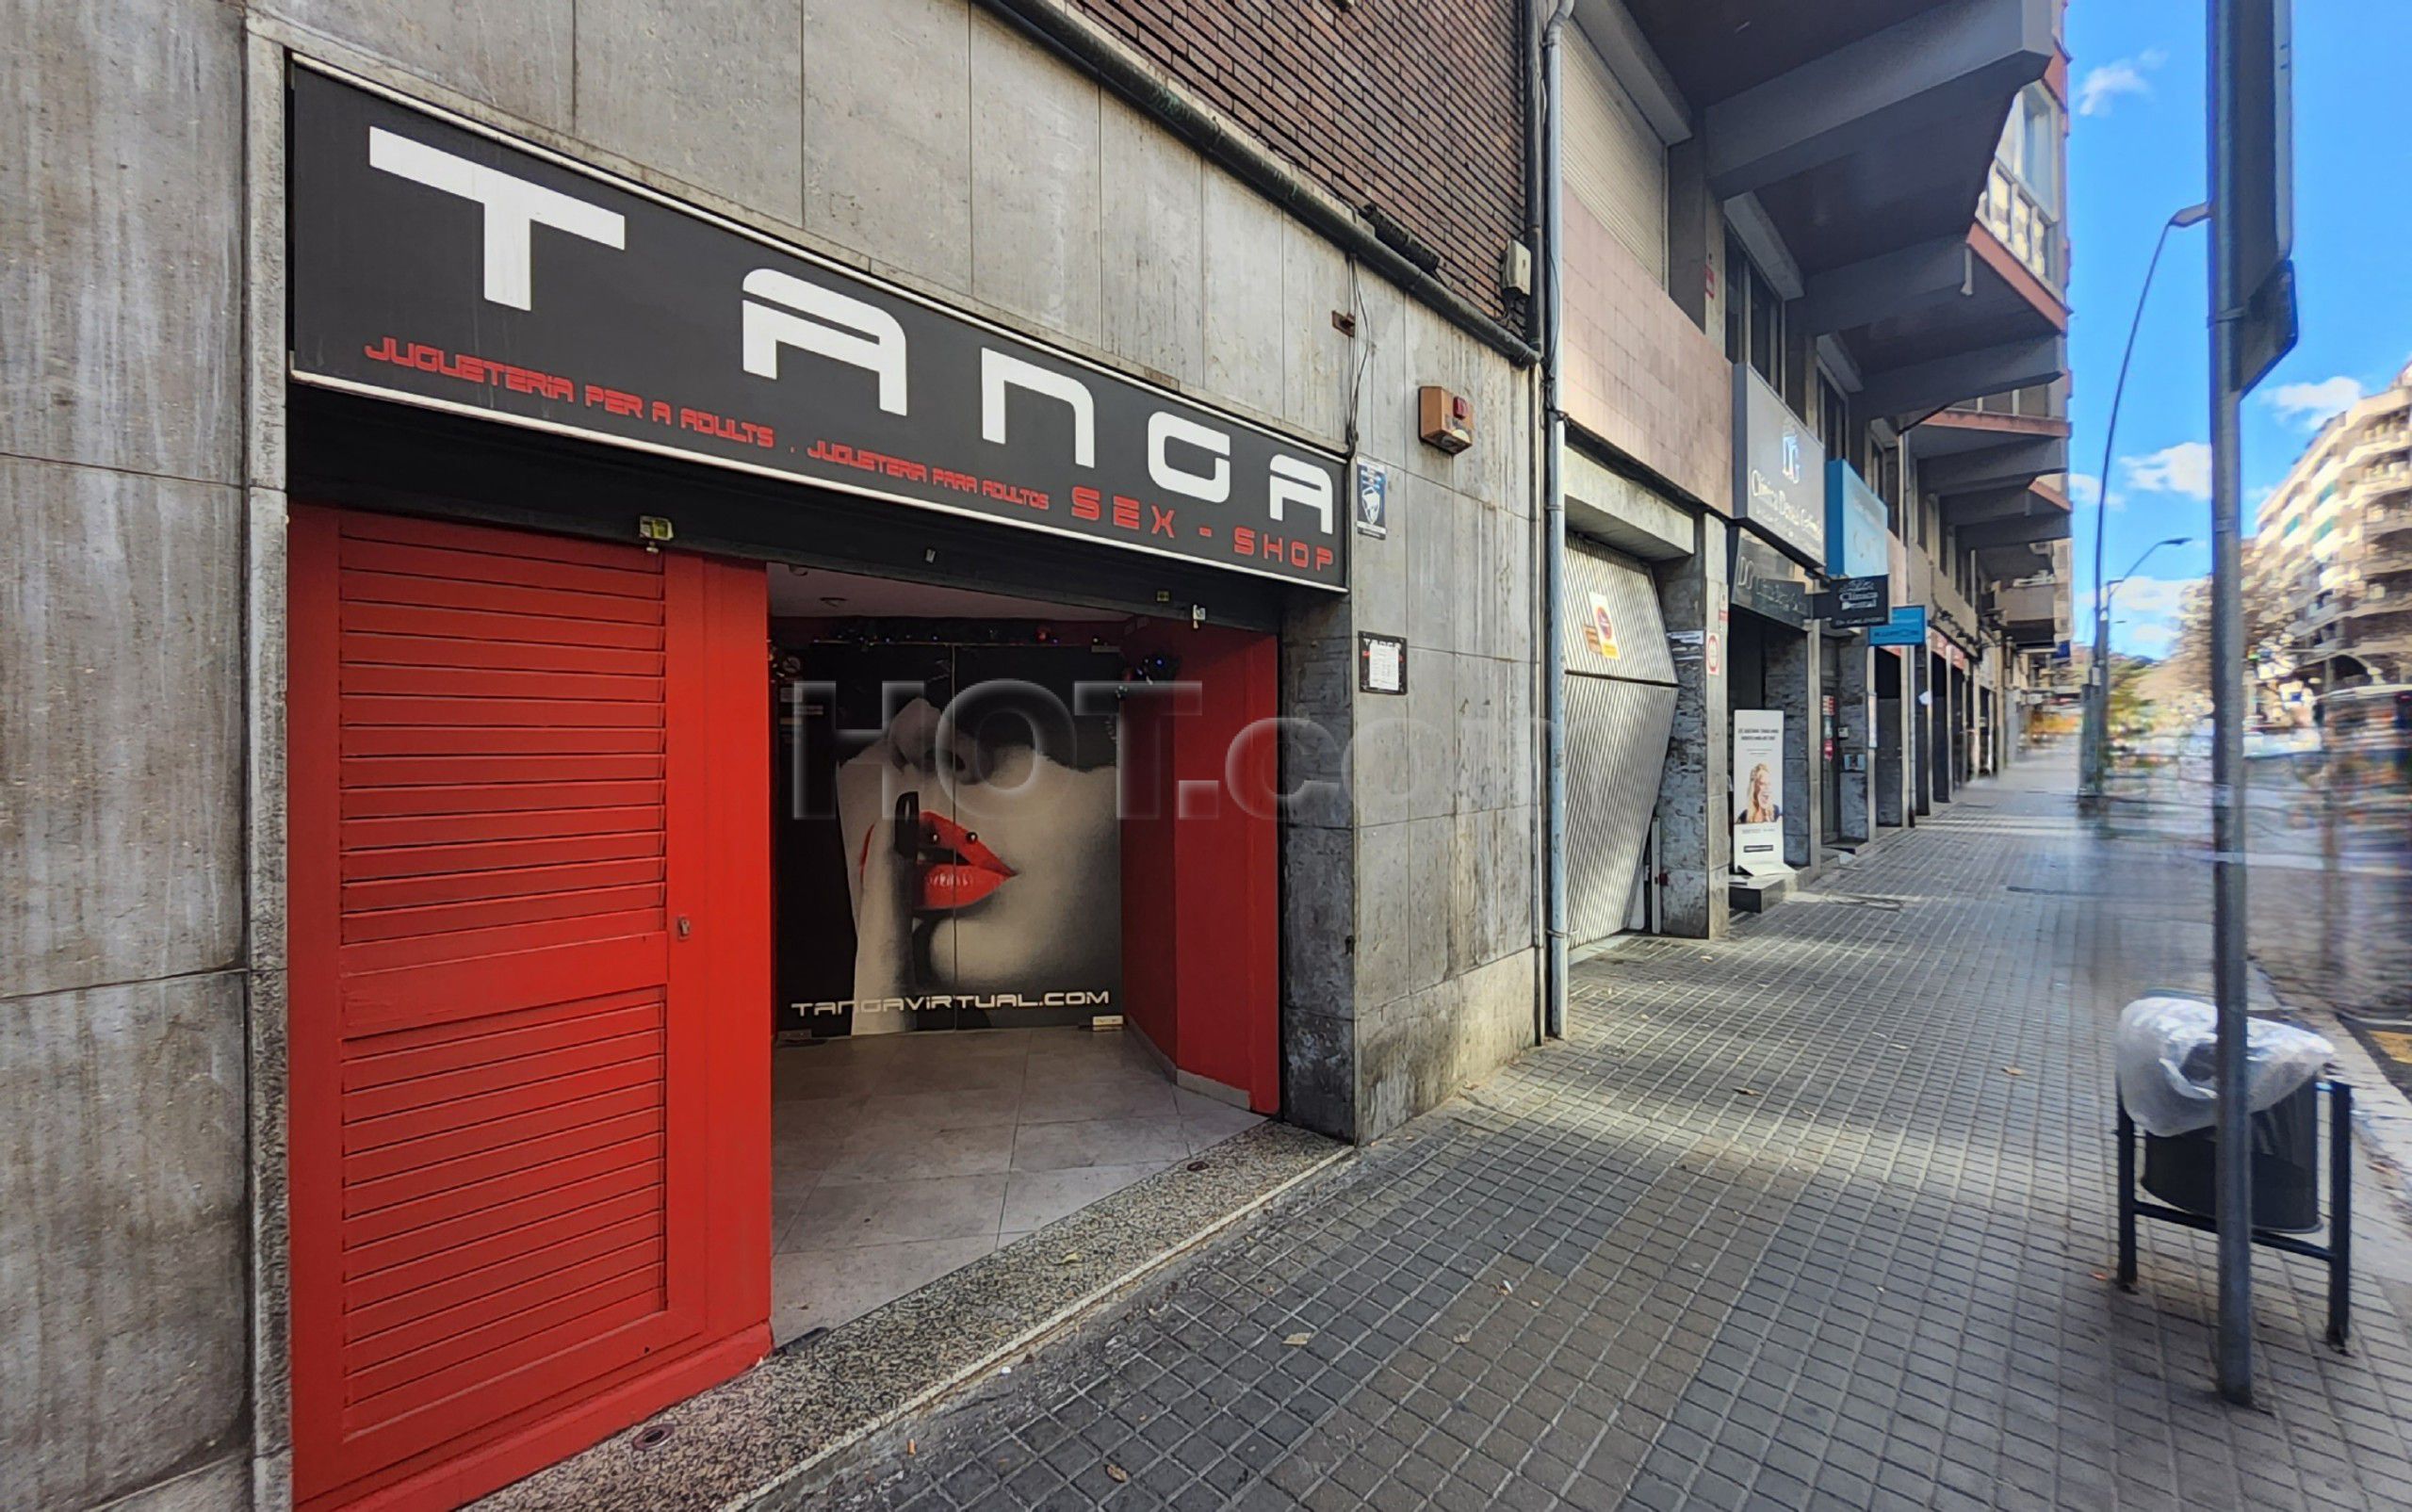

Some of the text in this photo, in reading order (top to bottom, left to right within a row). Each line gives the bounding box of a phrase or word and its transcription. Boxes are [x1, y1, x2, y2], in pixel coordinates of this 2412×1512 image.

[368, 125, 1333, 534] TANGA
[365, 336, 575, 403] JUGUETERIA
[584, 384, 644, 419] PER
[651, 400, 672, 426] A
[679, 407, 774, 448] ADULTS
[932, 466, 978, 495] PARA
[982, 479, 1050, 512] ADULTOS
[1070, 485, 1176, 539] SEX
[1232, 526, 1334, 572] SHOP
[790, 990, 1110, 1017] TANGAVIRTUAL.COM
